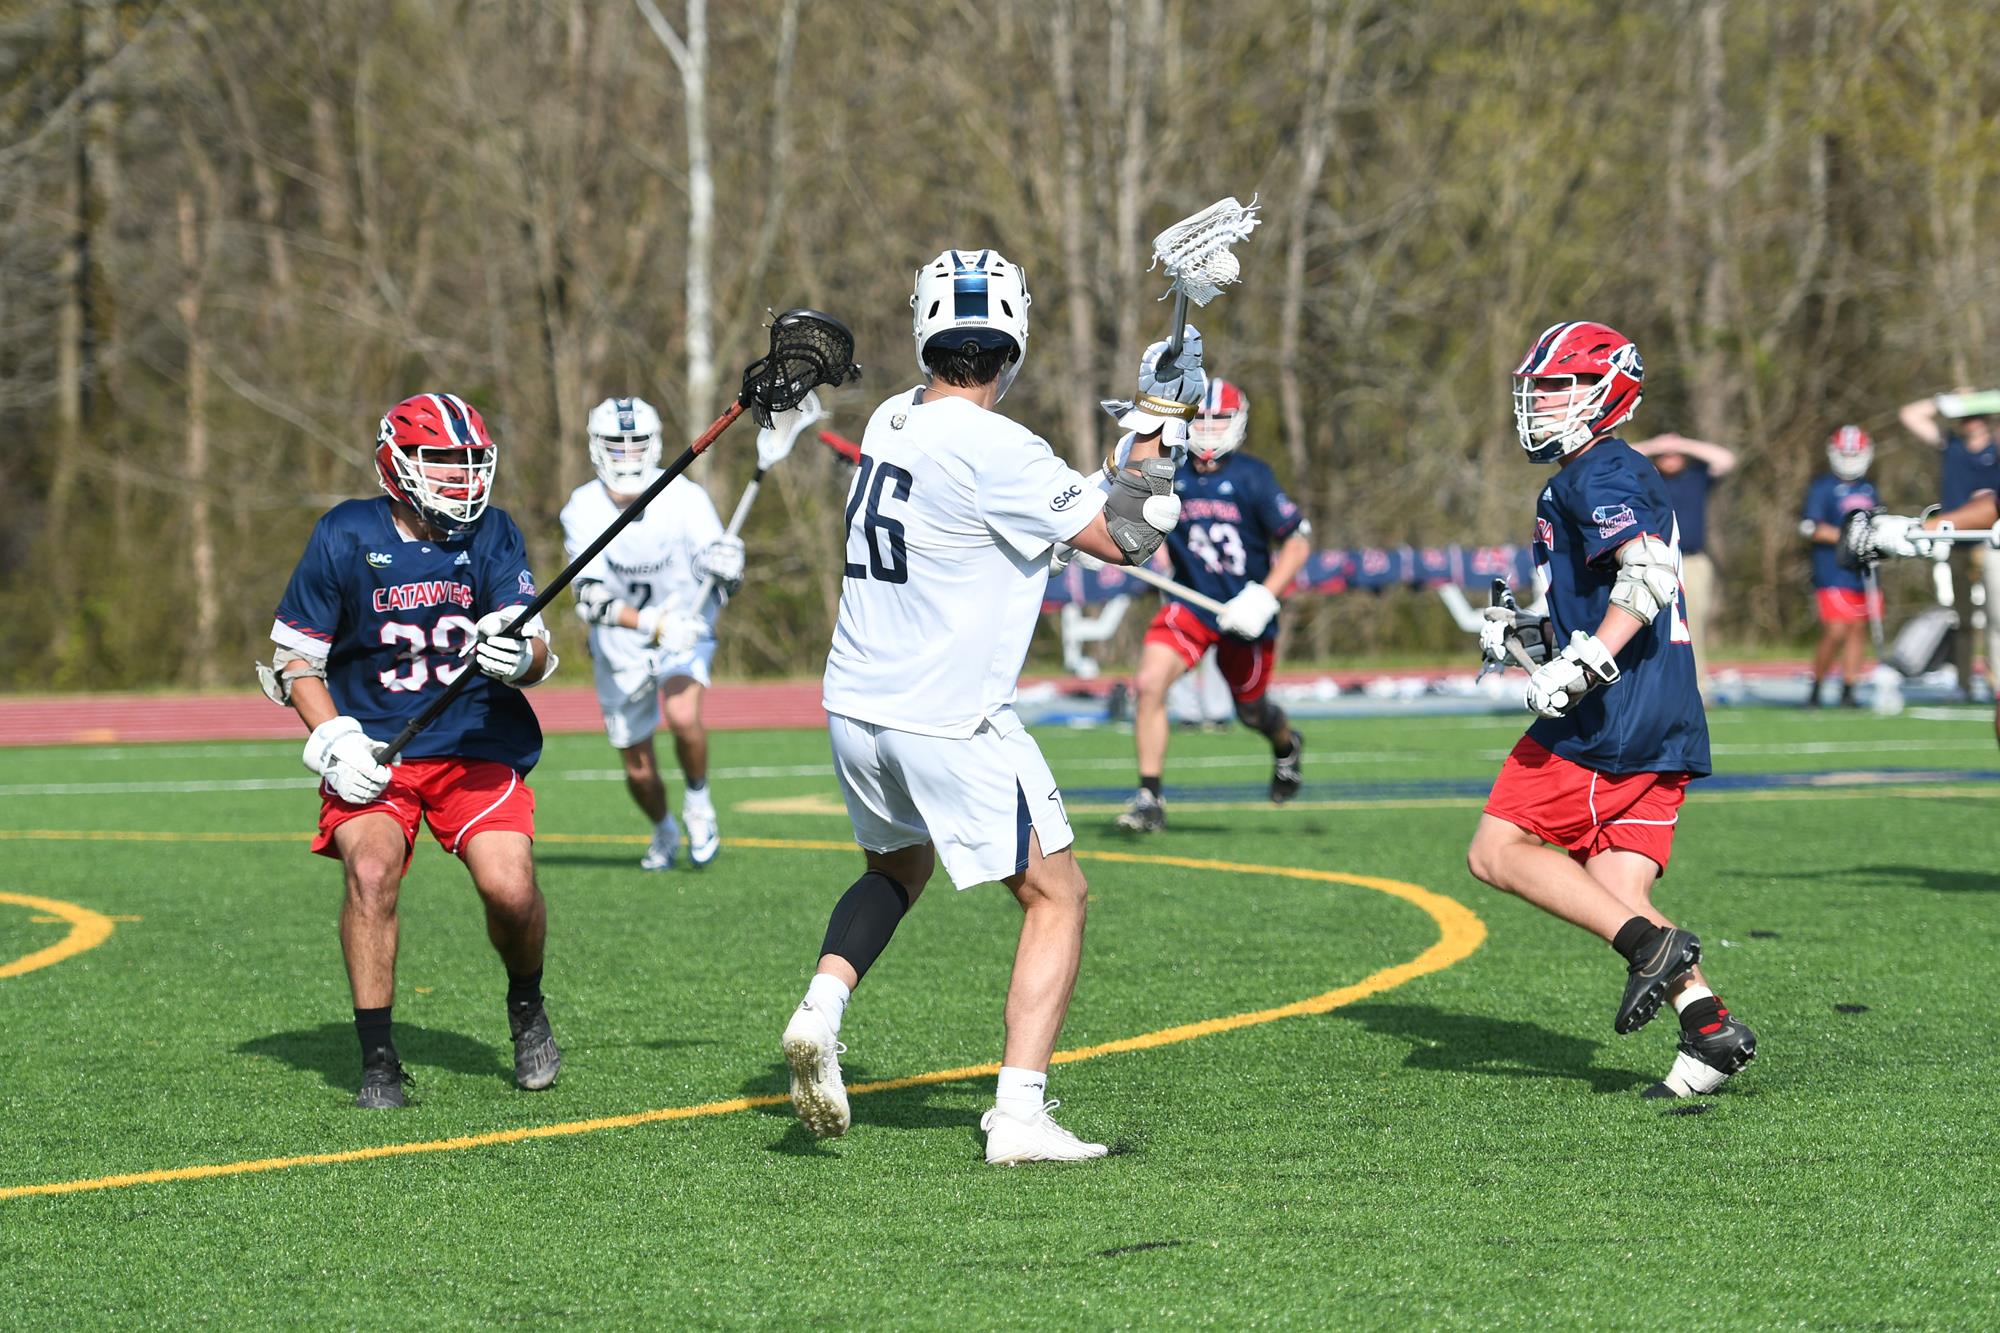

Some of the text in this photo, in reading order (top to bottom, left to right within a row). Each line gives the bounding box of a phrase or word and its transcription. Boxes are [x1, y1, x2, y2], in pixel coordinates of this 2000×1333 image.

[1139, 399, 1186, 415] WARRIOR
[1053, 484, 1082, 509] SAC
[844, 452, 913, 585] 26
[369, 552, 393, 565] SAC
[1187, 522, 1247, 577] 43
[379, 614, 478, 693] 39
